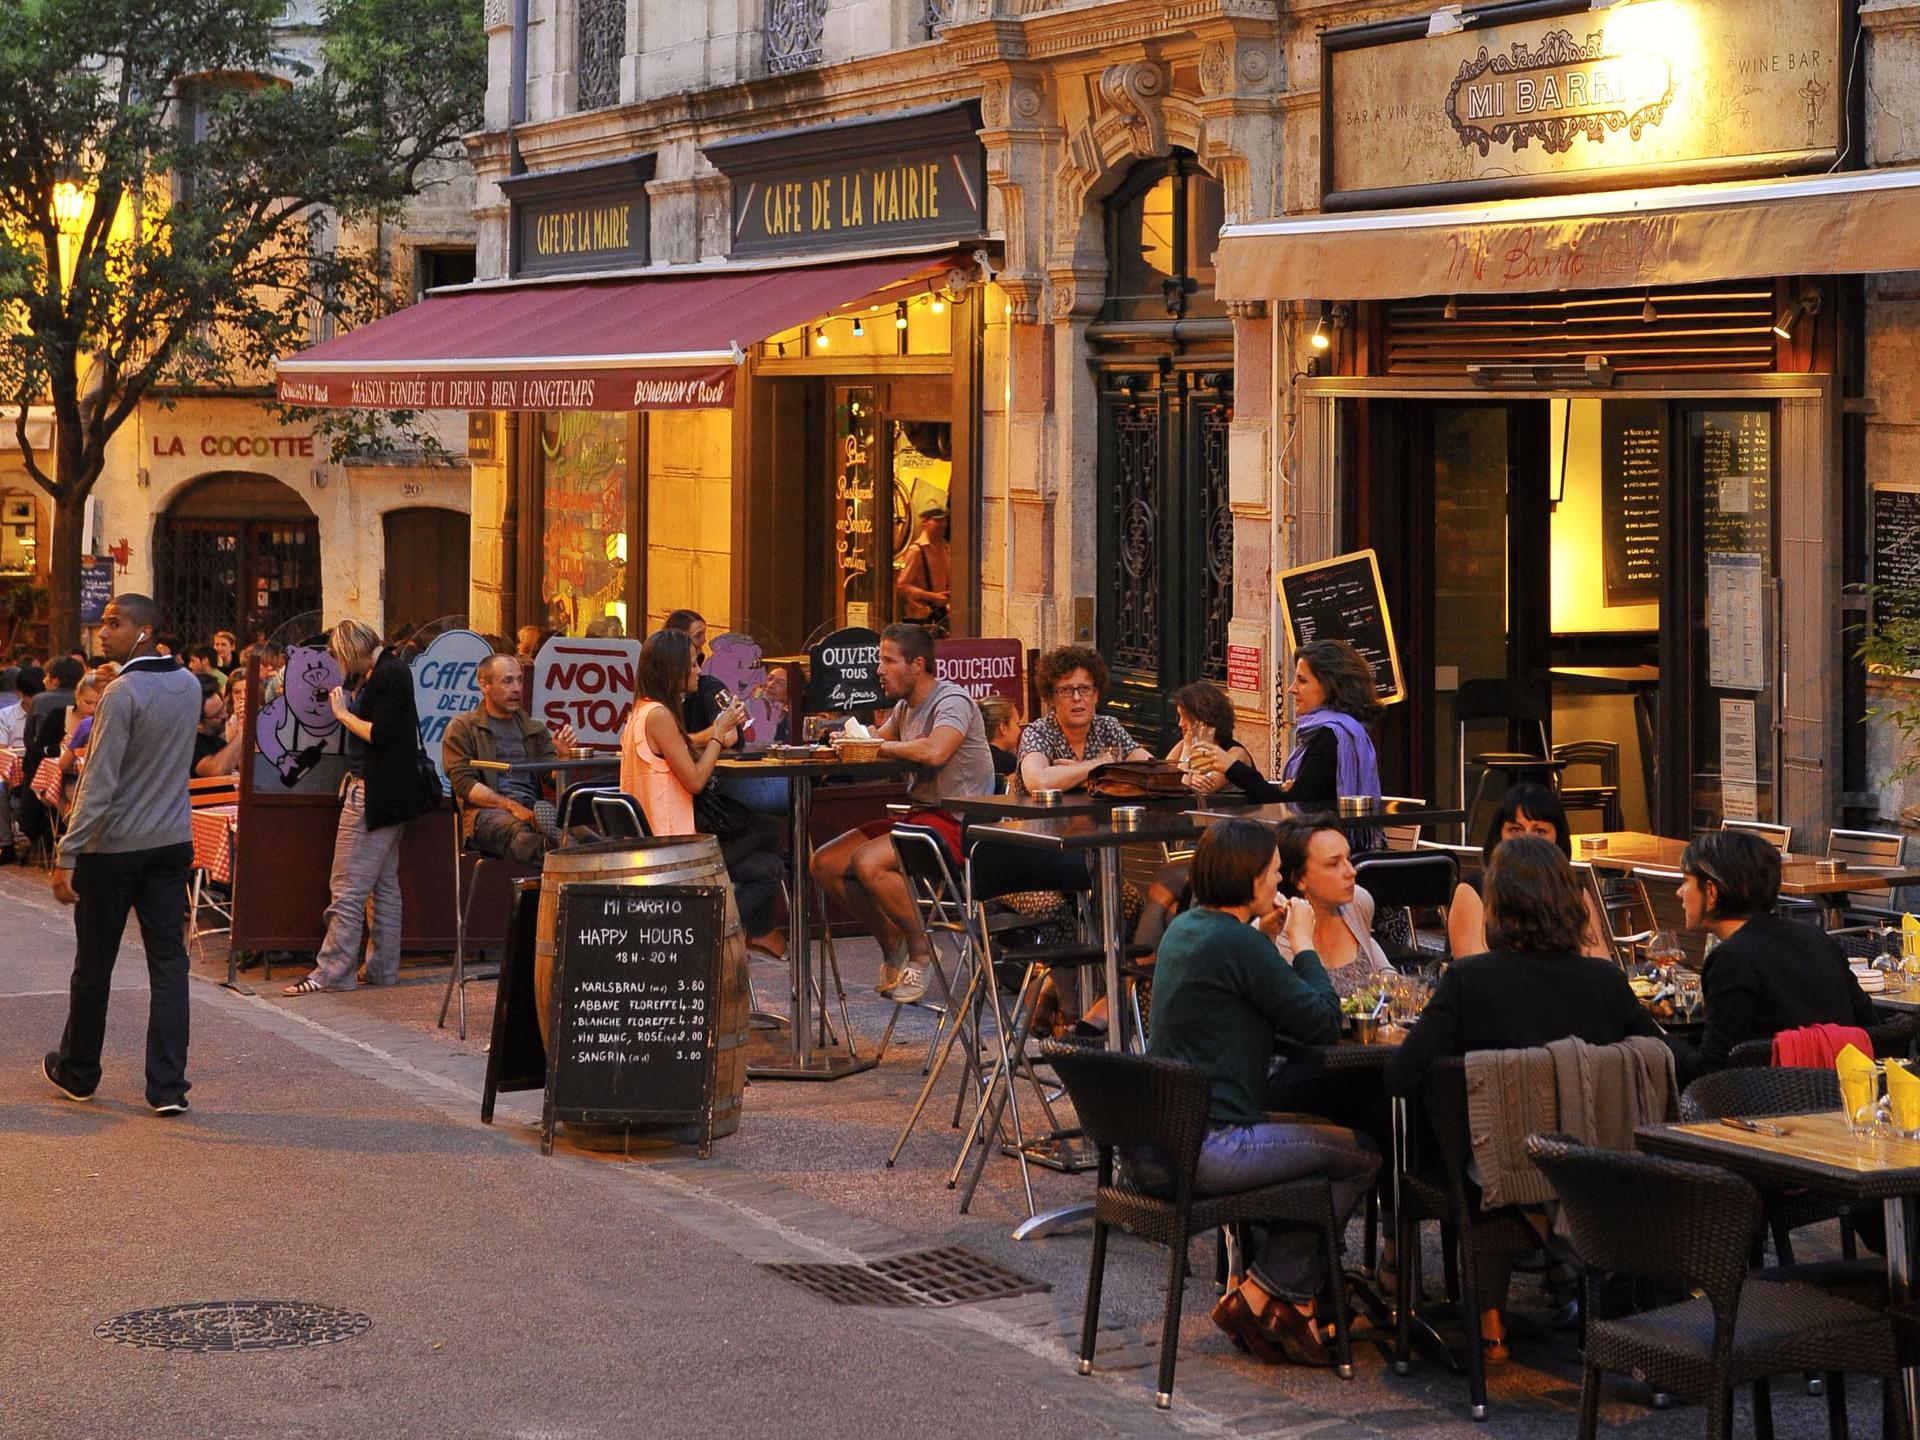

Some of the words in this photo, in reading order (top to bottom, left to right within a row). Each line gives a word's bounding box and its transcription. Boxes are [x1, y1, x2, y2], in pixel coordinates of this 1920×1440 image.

[1739, 55, 1779, 75] WINE
[1788, 50, 1821, 70] BAR
[1467, 81, 1504, 119] MI
[1515, 68, 1640, 113] BARR
[1346, 108, 1368, 126] BAR
[1388, 104, 1408, 120] VIN
[763, 182, 802, 236] CAFE
[811, 178, 832, 231] DE
[841, 175, 863, 227] LA
[873, 163, 939, 225] MAIRIE
[537, 213, 560, 255] CAFE
[562, 211, 575, 253] DE
[578, 208, 591, 252] LA
[593, 206, 629, 250] MAIRIE
[351, 380, 385, 405] MAISON
[389, 374, 426, 405] FONDÉE
[431, 381, 445, 405] ICI
[450, 381, 486, 406] DEPUIS
[491, 381, 517, 406] BIEN
[522, 379, 595, 406] LONGTEMPS
[153, 436, 185, 456] LA
[200, 435, 314, 457] COCOTTE
[822, 646, 881, 666] OUVER
[545, 662, 634, 694] NON
[840, 667, 868, 680] TOUS
[935, 656, 1016, 681] BOUCHON
[829, 684, 846, 700] les
[844, 688, 878, 710] jours
[963, 683, 993, 698] AINT
[437, 693, 460, 711] DE
[603, 899, 621, 916] MI
[627, 900, 682, 915] BARRIO
[578, 928, 628, 946] HAPPY
[640, 928, 694, 945] HOURS
[582, 981, 645, 994] KARLSBRAU
[580, 1000, 620, 1011] ABBAYE
[629, 1000, 677, 1011] FLOREFFE
[578, 1017, 621, 1027] BLANCHE
[627, 1016, 676, 1028] FLOREFFE
[578, 1051, 627, 1064] SANGRIA
[676, 1050, 701, 1061] 3.00
